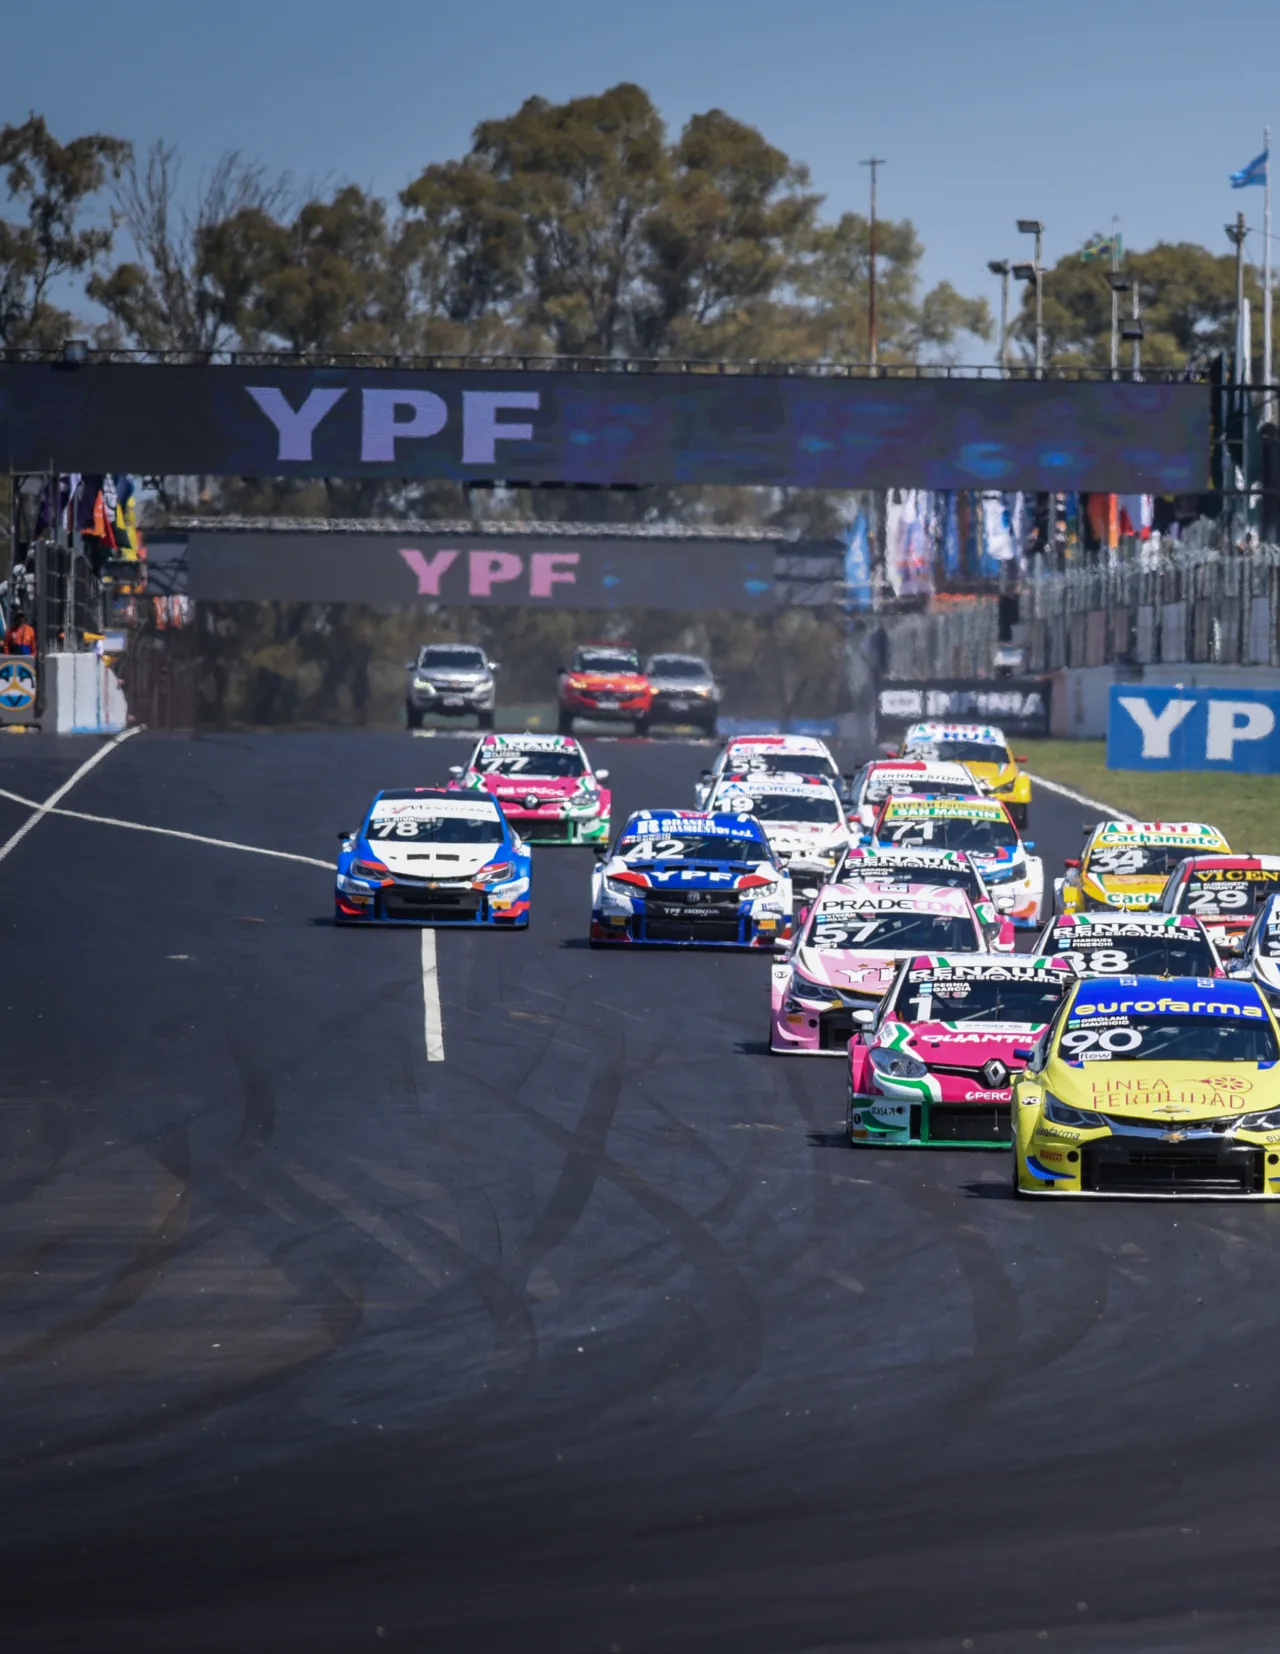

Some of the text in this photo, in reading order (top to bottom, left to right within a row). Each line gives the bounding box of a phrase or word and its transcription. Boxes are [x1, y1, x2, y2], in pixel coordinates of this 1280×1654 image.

[245, 386, 540, 464] YPF
[398, 548, 580, 597] YPF
[481, 757, 529, 772] 77
[715, 798, 754, 812] 19
[935, 809, 997, 819] MARTIN
[373, 821, 419, 837] 78
[886, 821, 934, 840] 71
[1102, 833, 1220, 846] Cachamate
[625, 840, 685, 860] 42
[1090, 849, 1147, 873] 34
[650, 871, 733, 882] YPF
[822, 899, 964, 915] PRADECON
[1188, 890, 1248, 910] 29
[813, 922, 880, 943] 57
[1053, 923, 1201, 938] RENAULT
[909, 966, 1075, 980] RENAULT
[909, 974, 1064, 985] CONCESIONARIO
[909, 995, 932, 1021] 1
[1075, 998, 1263, 1018] eurofarma
[1061, 1028, 1143, 1055] 90
[1080, 1052, 1111, 1060] flow
[1093, 1090, 1245, 1110] FERTILIDAD
